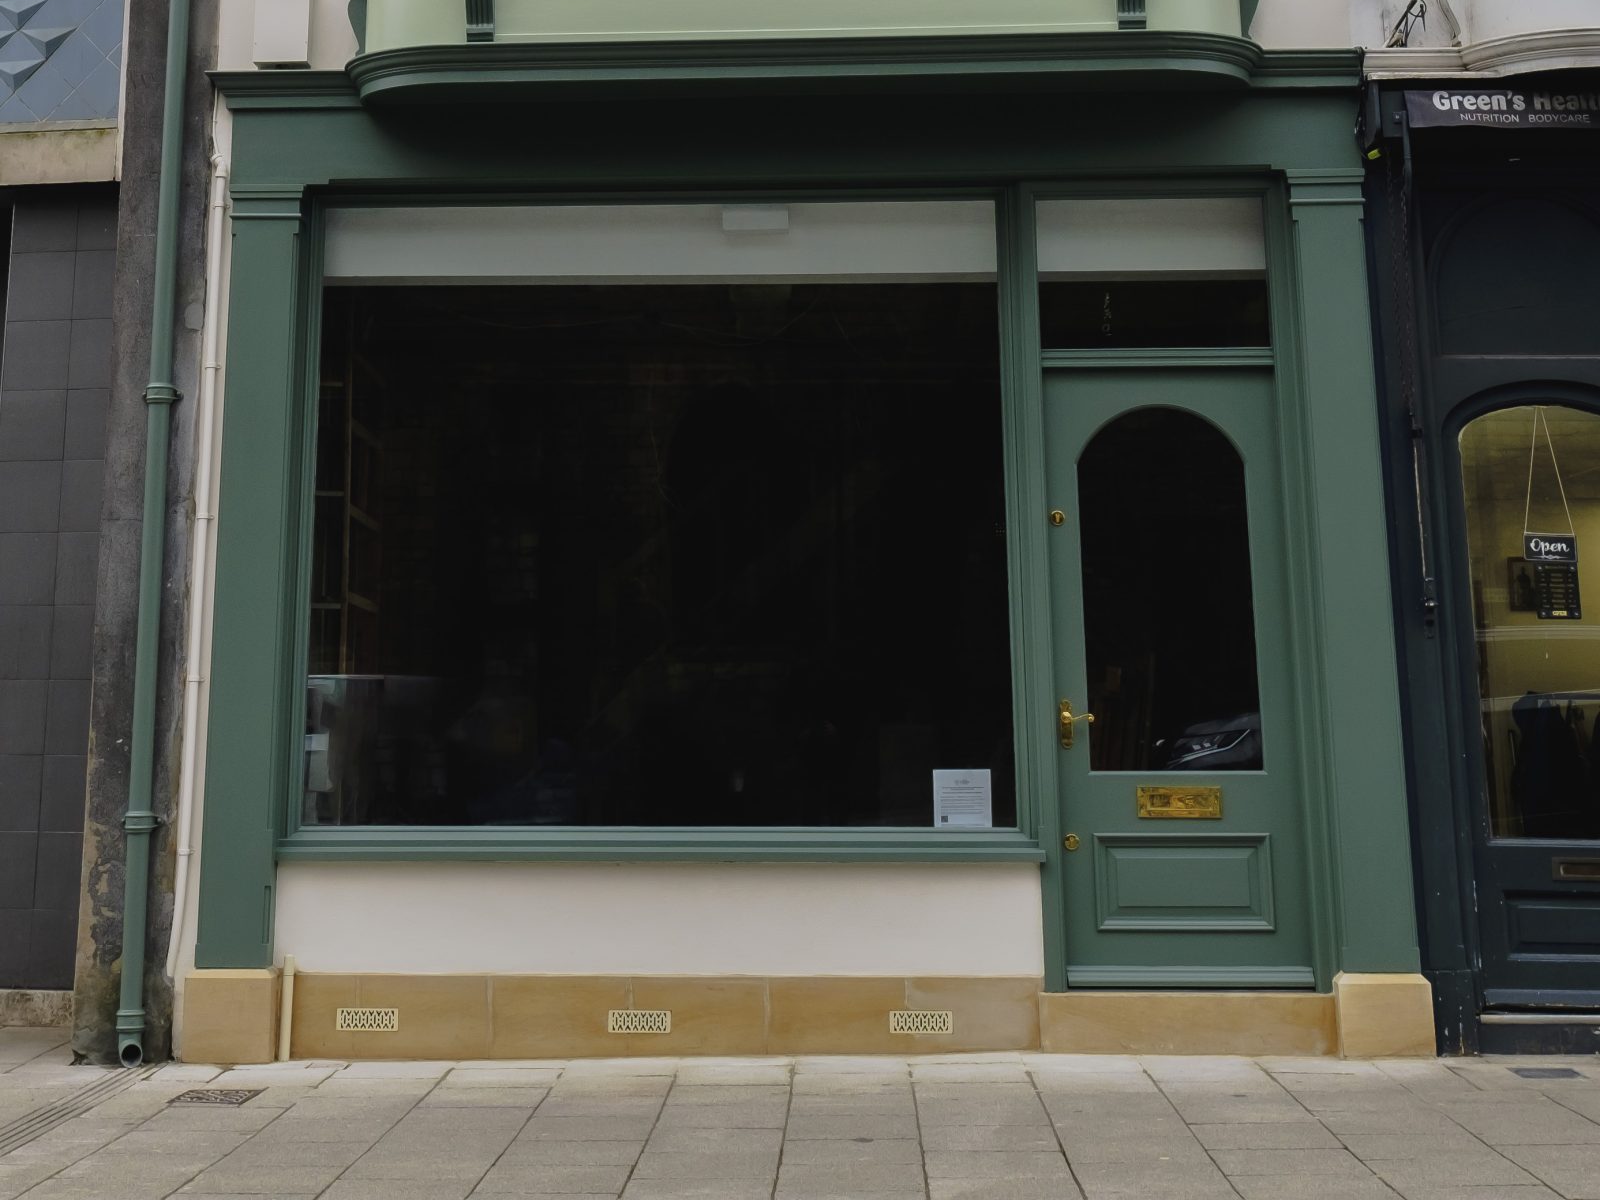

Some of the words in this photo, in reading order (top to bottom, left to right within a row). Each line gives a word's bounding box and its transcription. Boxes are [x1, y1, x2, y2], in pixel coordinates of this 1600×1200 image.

[1432, 91, 1526, 111] Green's
[1460, 113, 1520, 123] NUTRITION
[1528, 114, 1591, 123] BODYCARE
[1530, 538, 1570, 556] Open
